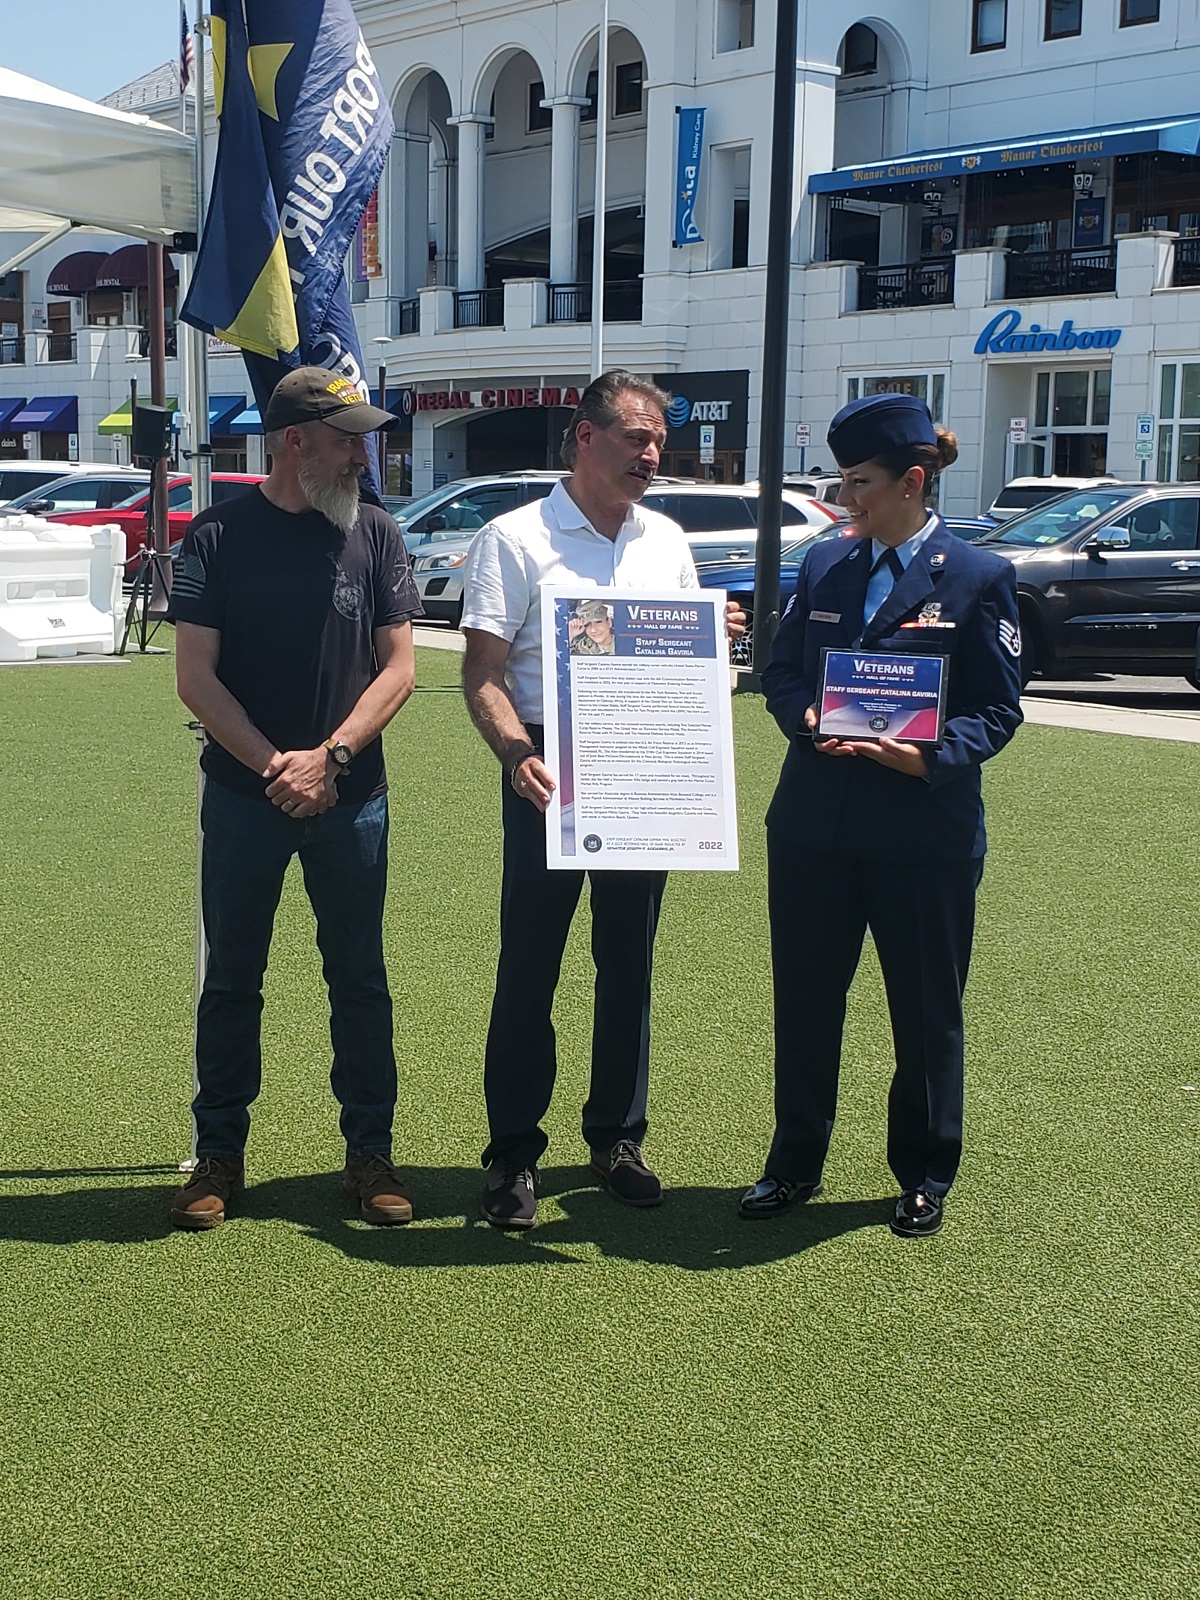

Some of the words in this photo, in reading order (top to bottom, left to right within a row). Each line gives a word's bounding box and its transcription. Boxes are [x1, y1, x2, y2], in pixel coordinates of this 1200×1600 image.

[694, 113, 702, 131] Care
[692, 132, 701, 160] Kidney
[1000, 145, 1037, 163] Manor
[1040, 141, 1104, 159] Oktoberfest
[852, 168, 885, 183] Manor
[887, 161, 943, 178] Oktoberfest
[102, 278, 121, 287] DENTAL
[973, 309, 1122, 355] Rainbow
[416, 390, 475, 411] REGAL
[690, 400, 732, 422] AT&T
[627, 605, 698, 621] VETERANS
[635, 637, 657, 647] STAFF
[658, 638, 693, 647] SERGEANT
[634, 647, 666, 656] CATALINA
[668, 647, 694, 656] GAVIRIA
[854, 659, 915, 675] VETERANS
[825, 685, 846, 693] STAFF
[846, 687, 880, 696] SERGEANT
[880, 688, 911, 697] CATALINA
[912, 690, 938, 699] GAVIRIA
[698, 841, 723, 850] 2022
